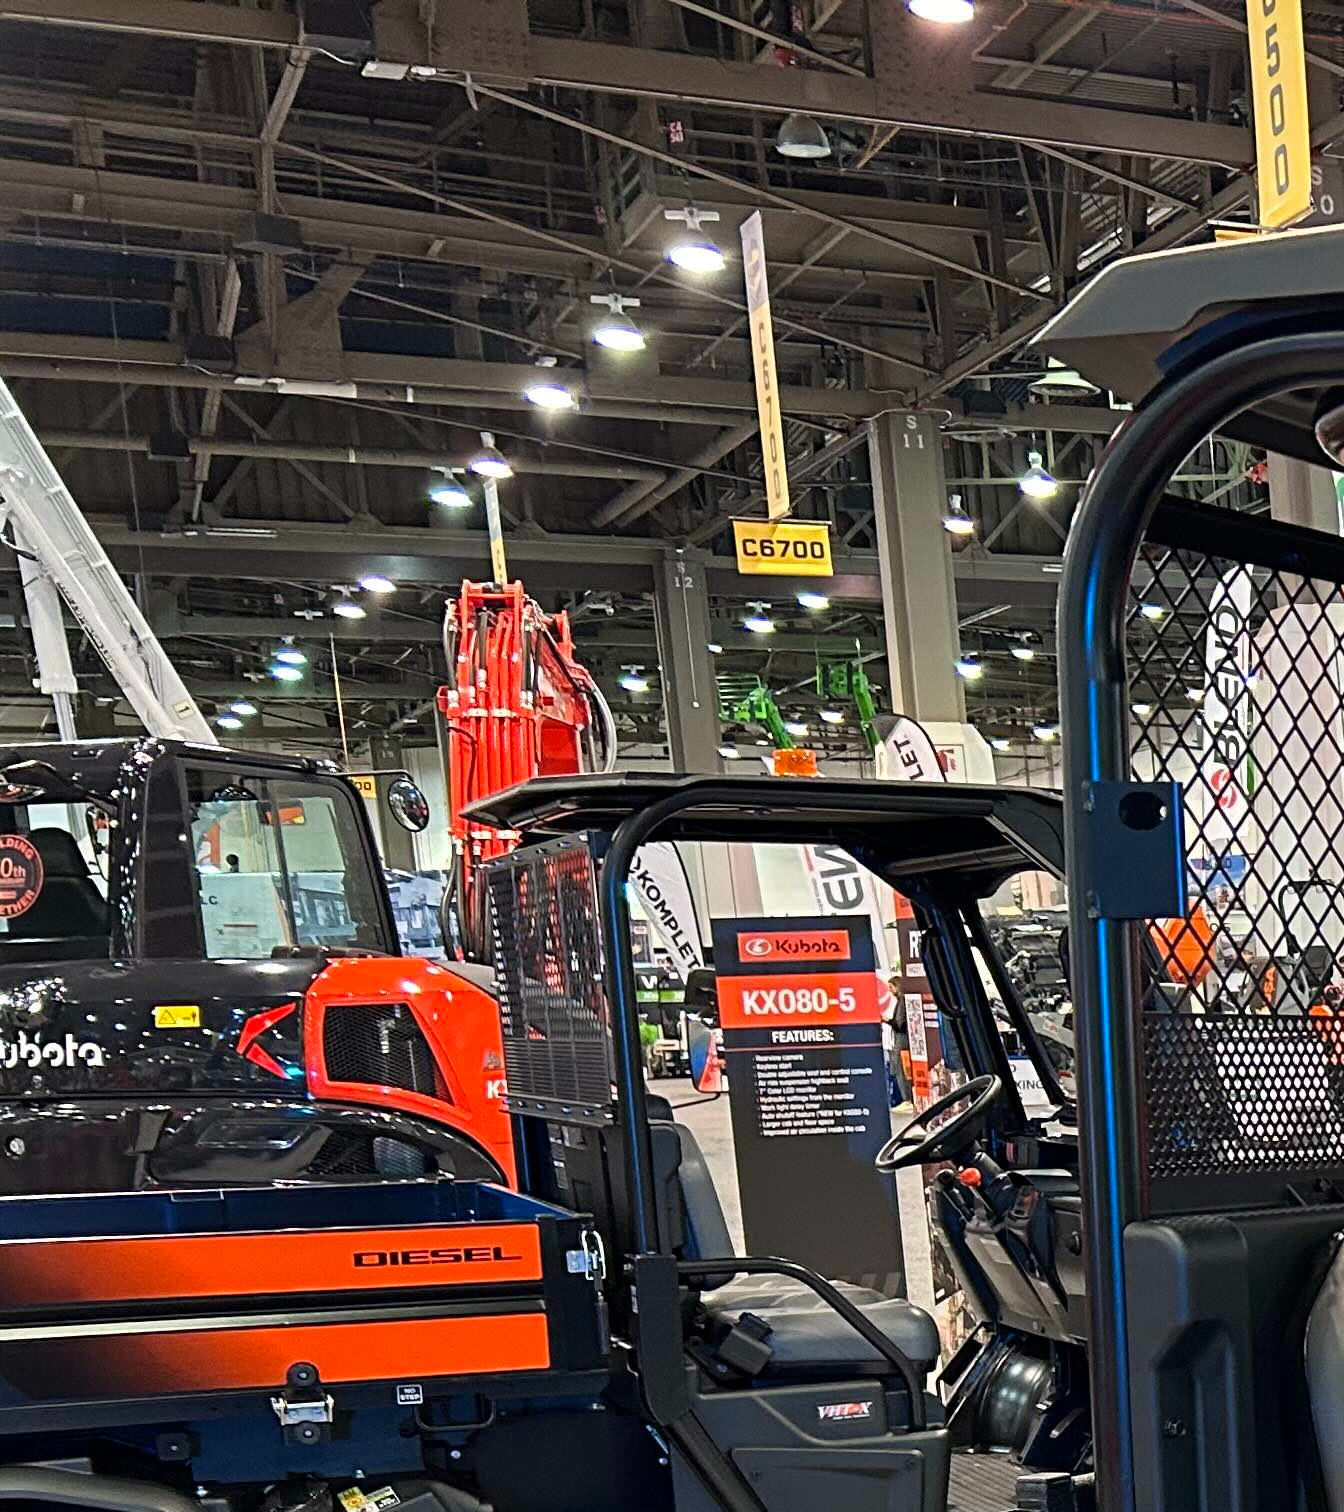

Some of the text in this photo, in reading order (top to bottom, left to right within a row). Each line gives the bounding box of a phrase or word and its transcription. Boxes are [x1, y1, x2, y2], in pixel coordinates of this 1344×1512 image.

[741, 538, 826, 560] C6700
[637, 869, 701, 969] KOMPLET
[775, 938, 841, 955] Kubota
[742, 987, 857, 1016] KX080-5
[771, 1028, 835, 1043] FEATURES:
[353, 1247, 523, 1267] DIESEL
